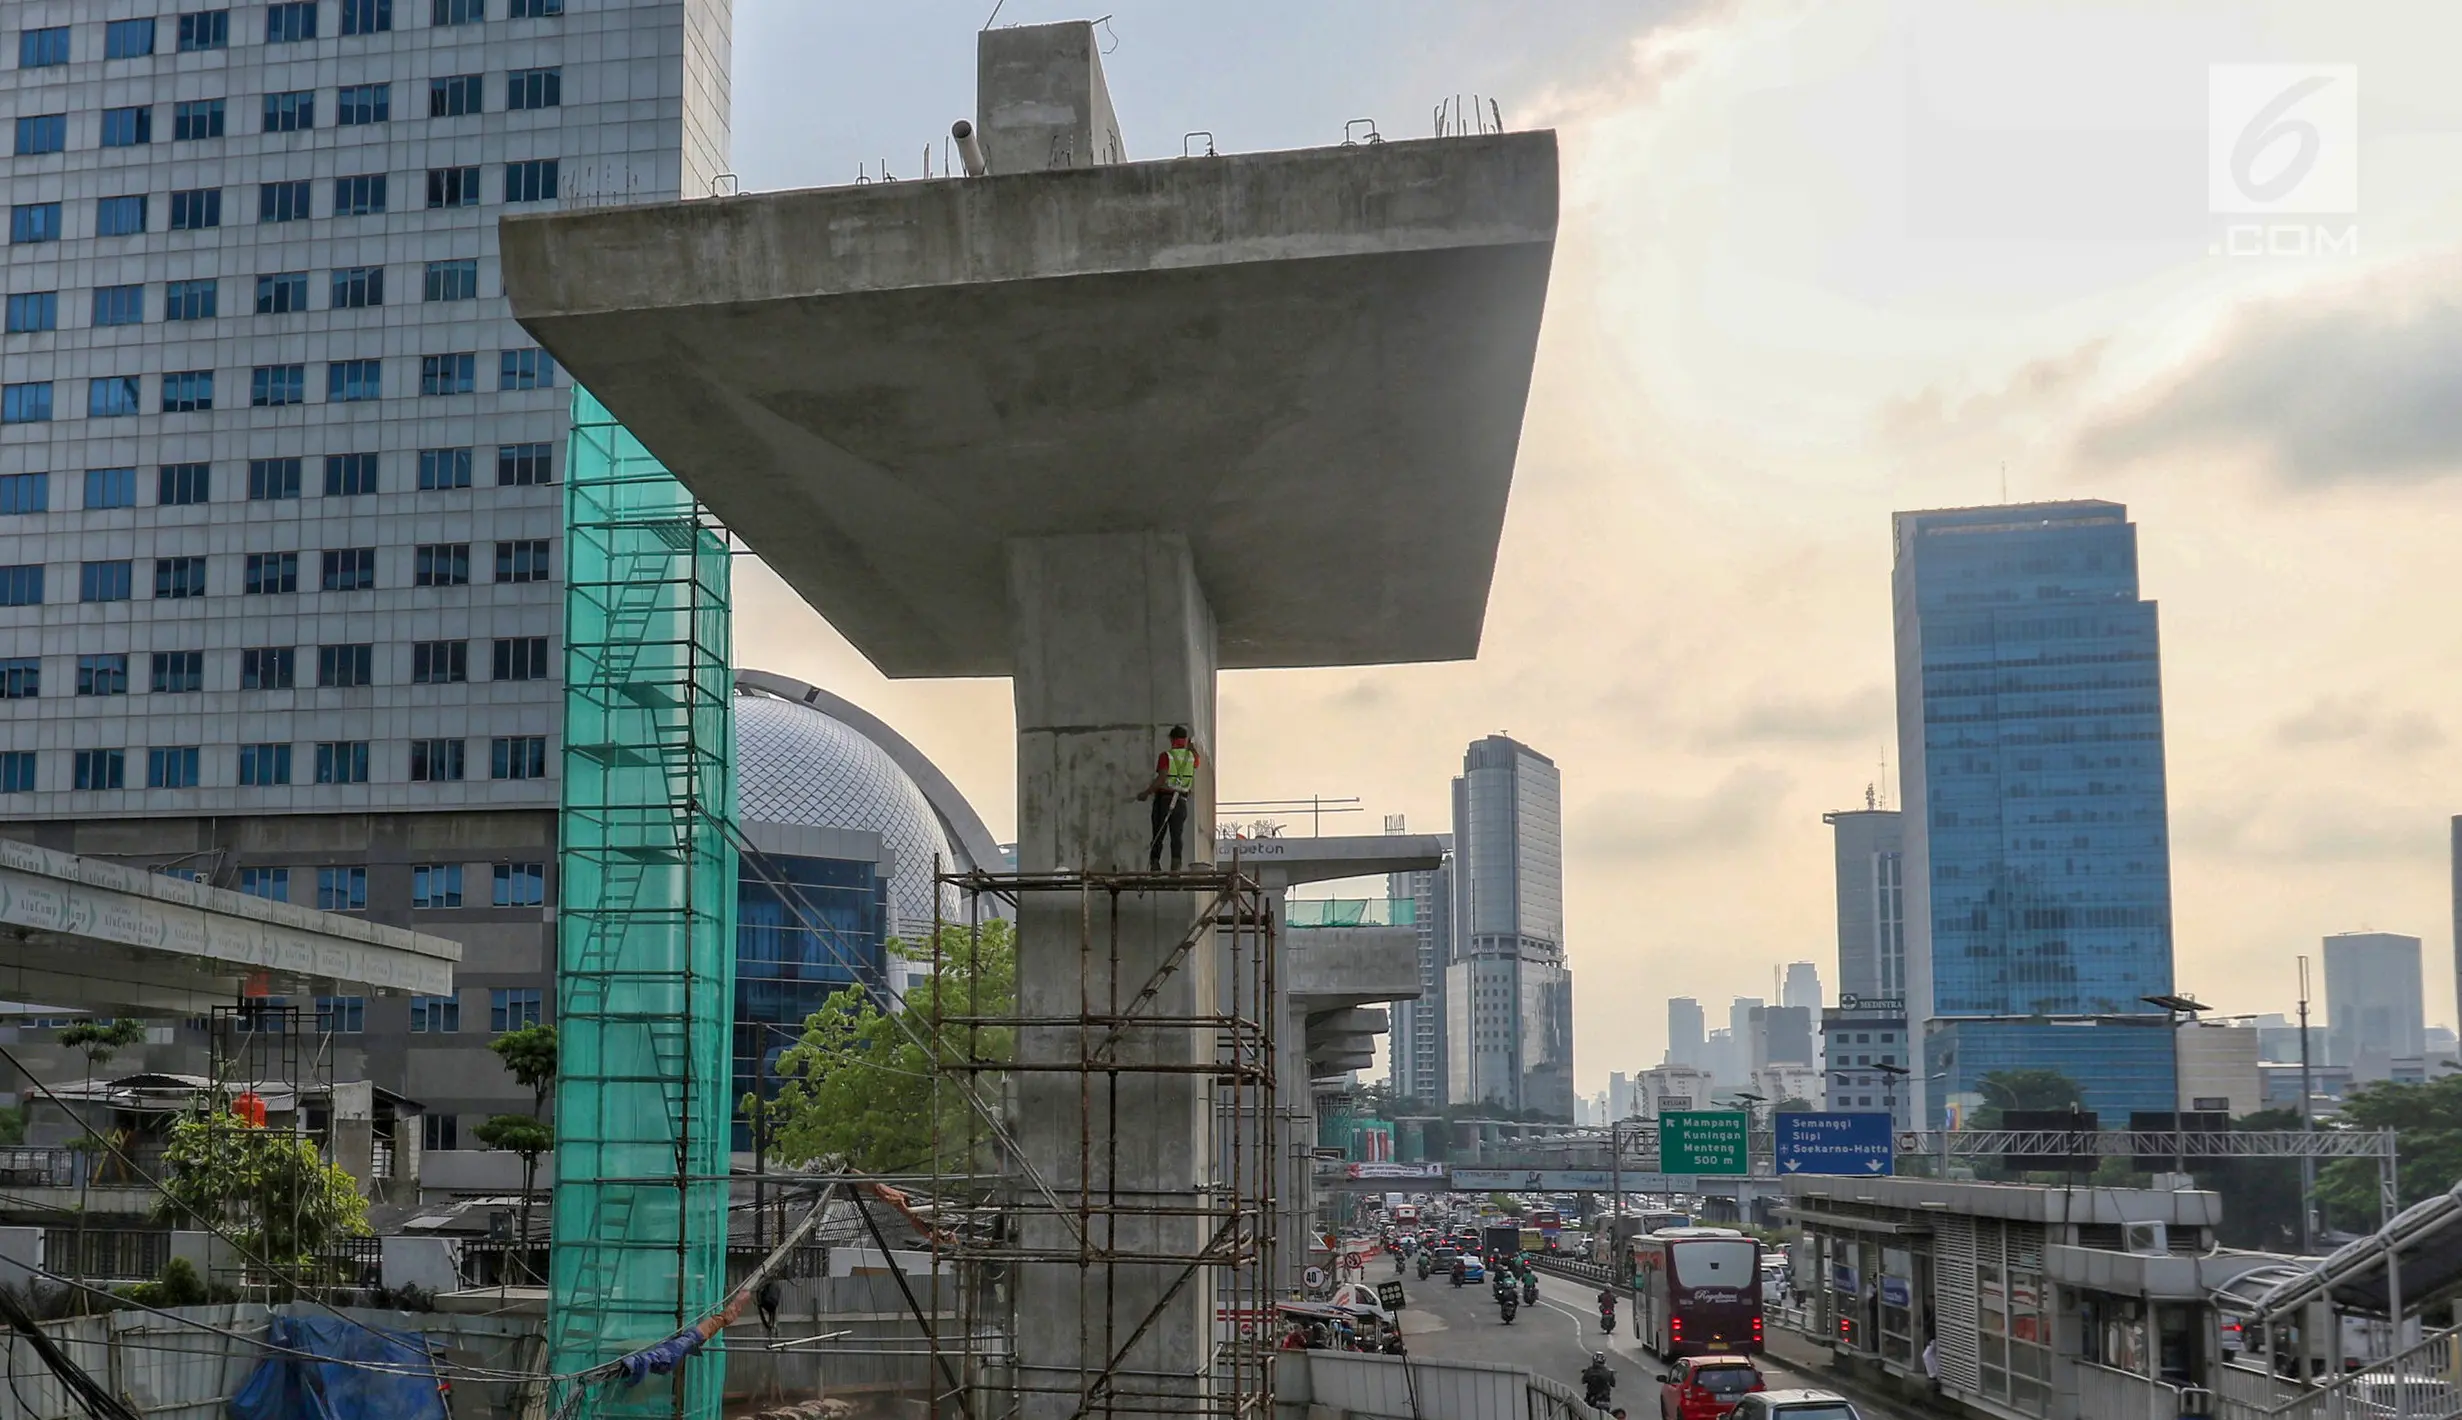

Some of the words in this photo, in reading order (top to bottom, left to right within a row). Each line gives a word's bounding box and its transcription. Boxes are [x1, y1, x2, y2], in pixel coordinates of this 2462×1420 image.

[1683, 1118, 1741, 1130] Mampang
[1792, 1118, 1852, 1130] Semanggi
[1683, 1130, 1741, 1143] Kuningan
[1792, 1131, 1821, 1142] Slipi
[1683, 1143, 1735, 1155] Menteng
[1792, 1143, 1889, 1155] Soekarno-Hatta
[1693, 1155, 1719, 1166] 500
[1723, 1157, 1734, 1165] m
[1306, 1271, 1317, 1283] 40
